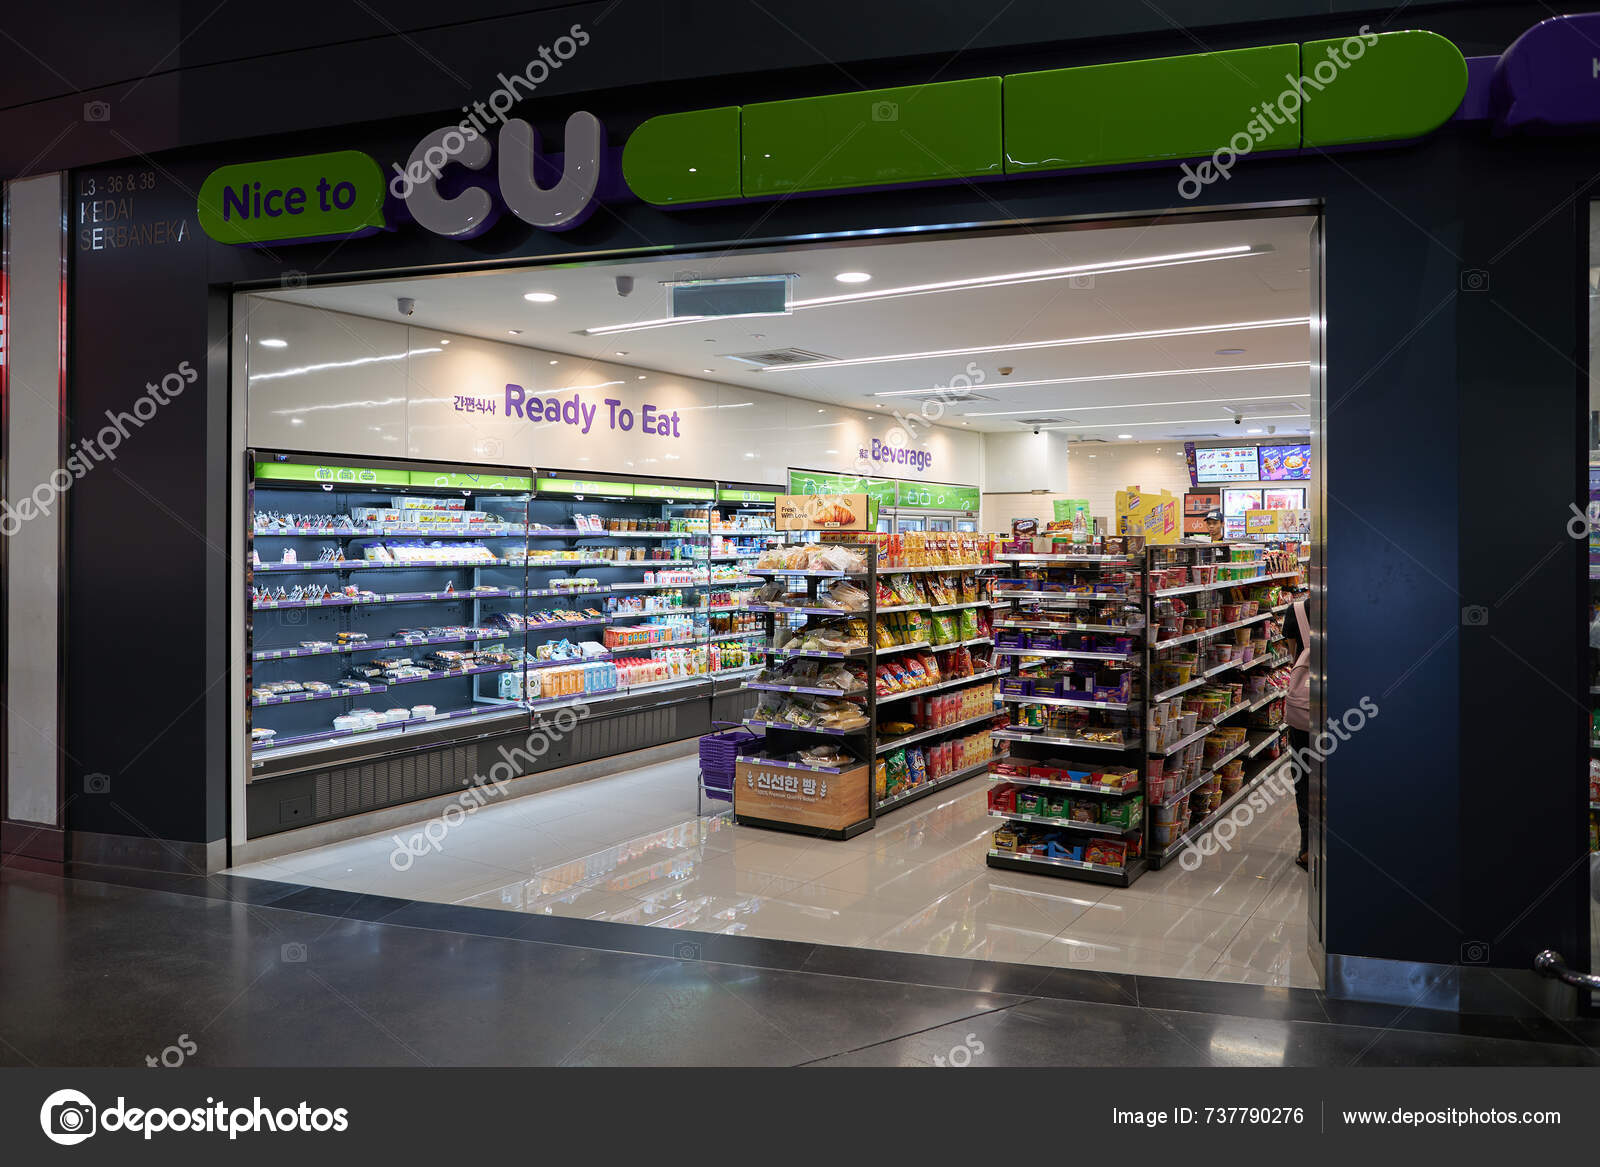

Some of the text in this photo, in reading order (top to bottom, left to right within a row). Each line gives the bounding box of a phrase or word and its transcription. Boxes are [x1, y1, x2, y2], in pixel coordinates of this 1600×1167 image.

[80, 178, 96, 197] L3
[107, 176, 123, 193] 36
[126, 174, 137, 191] &
[139, 171, 156, 190] 38
[404, 111, 602, 236] CU
[80, 198, 135, 224] KEDAI
[222, 177, 357, 221] Nice to
[79, 219, 192, 251] SERBANEKA
[453, 395, 497, 416] 간편식사
[505, 383, 681, 438] Ready To Eat
[871, 438, 932, 472] Beverage
[757, 771, 817, 796] 신선한 빵
